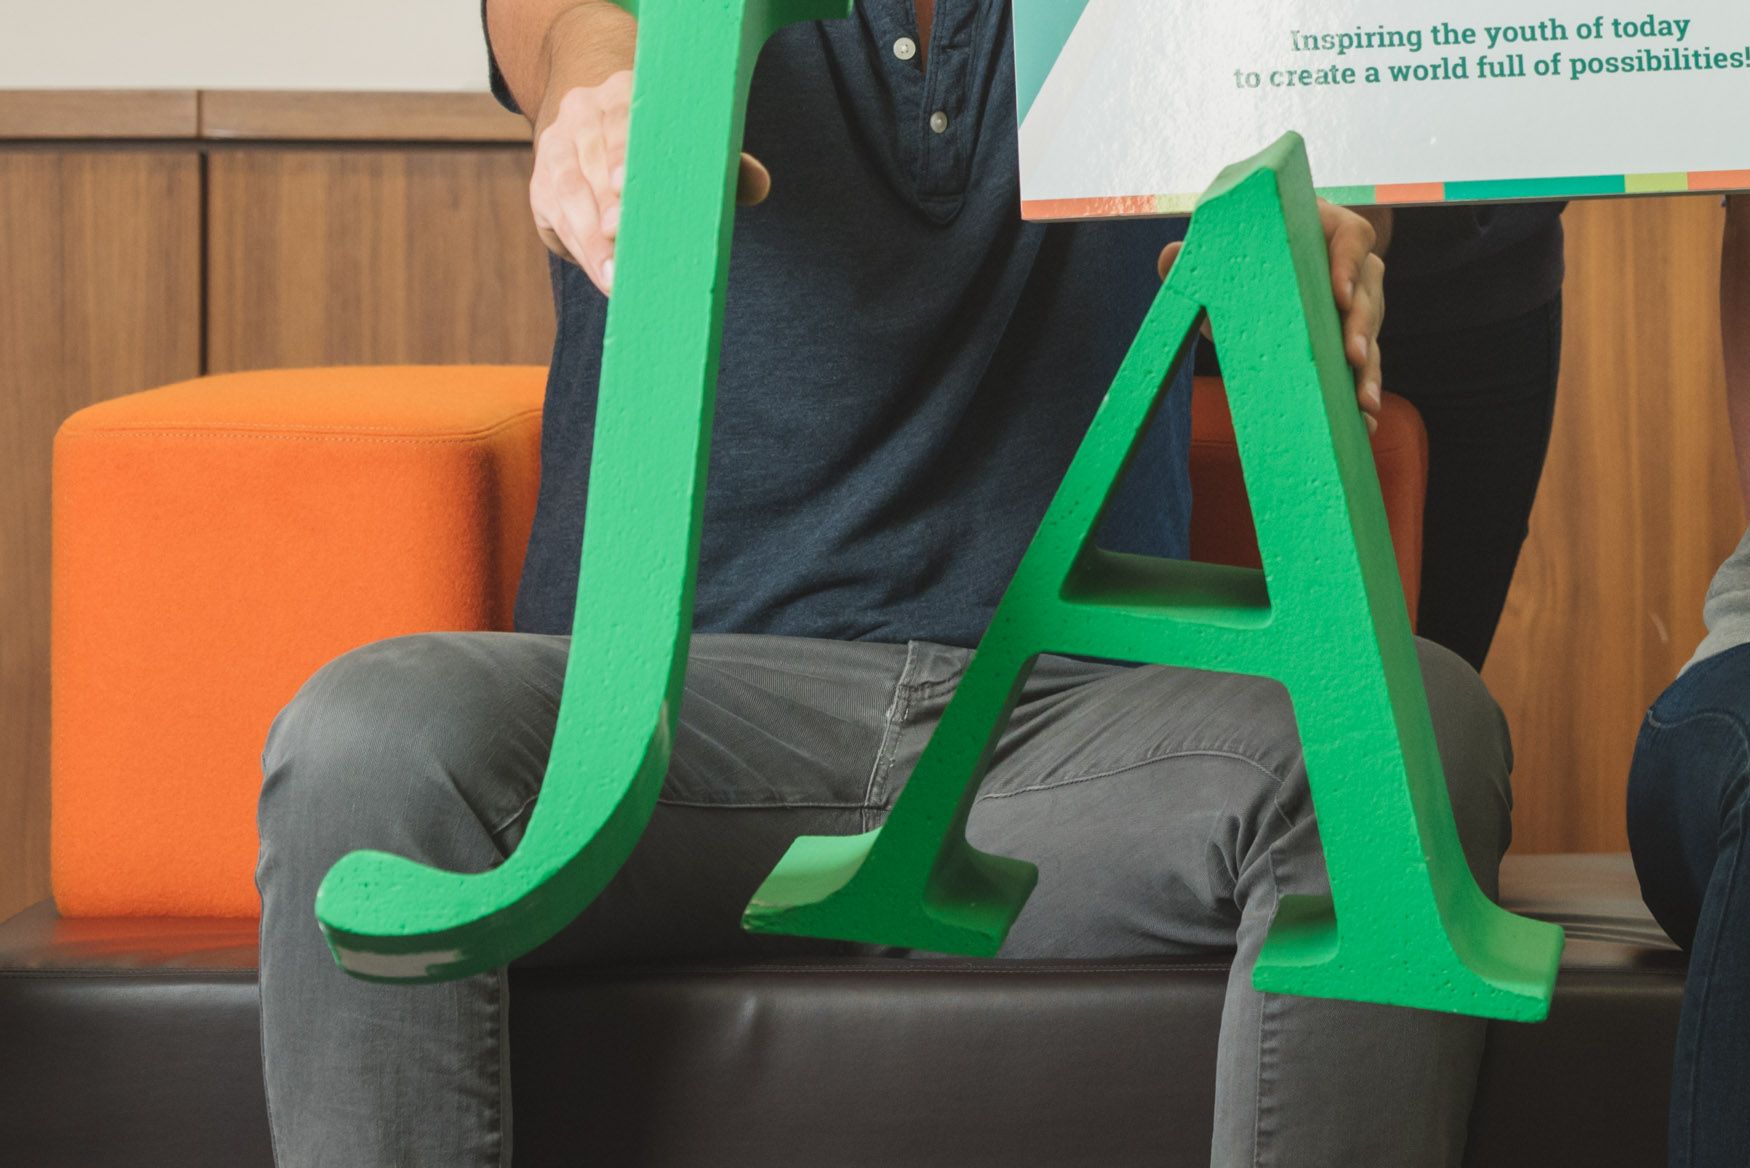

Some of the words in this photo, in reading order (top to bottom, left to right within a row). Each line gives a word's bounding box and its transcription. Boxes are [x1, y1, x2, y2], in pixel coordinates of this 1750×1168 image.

[1290, 25, 1422, 55] Inspiring
[1430, 22, 1477, 45] the
[1484, 18, 1569, 49] youth
[1576, 16, 1604, 40] of
[1611, 14, 1691, 42] today
[1233, 68, 1262, 89] to
[1269, 64, 1356, 87] create
[1364, 66, 1381, 83] a
[1387, 57, 1470, 82] world
[1476, 54, 1526, 78] full
[1533, 53, 1562, 76] of
